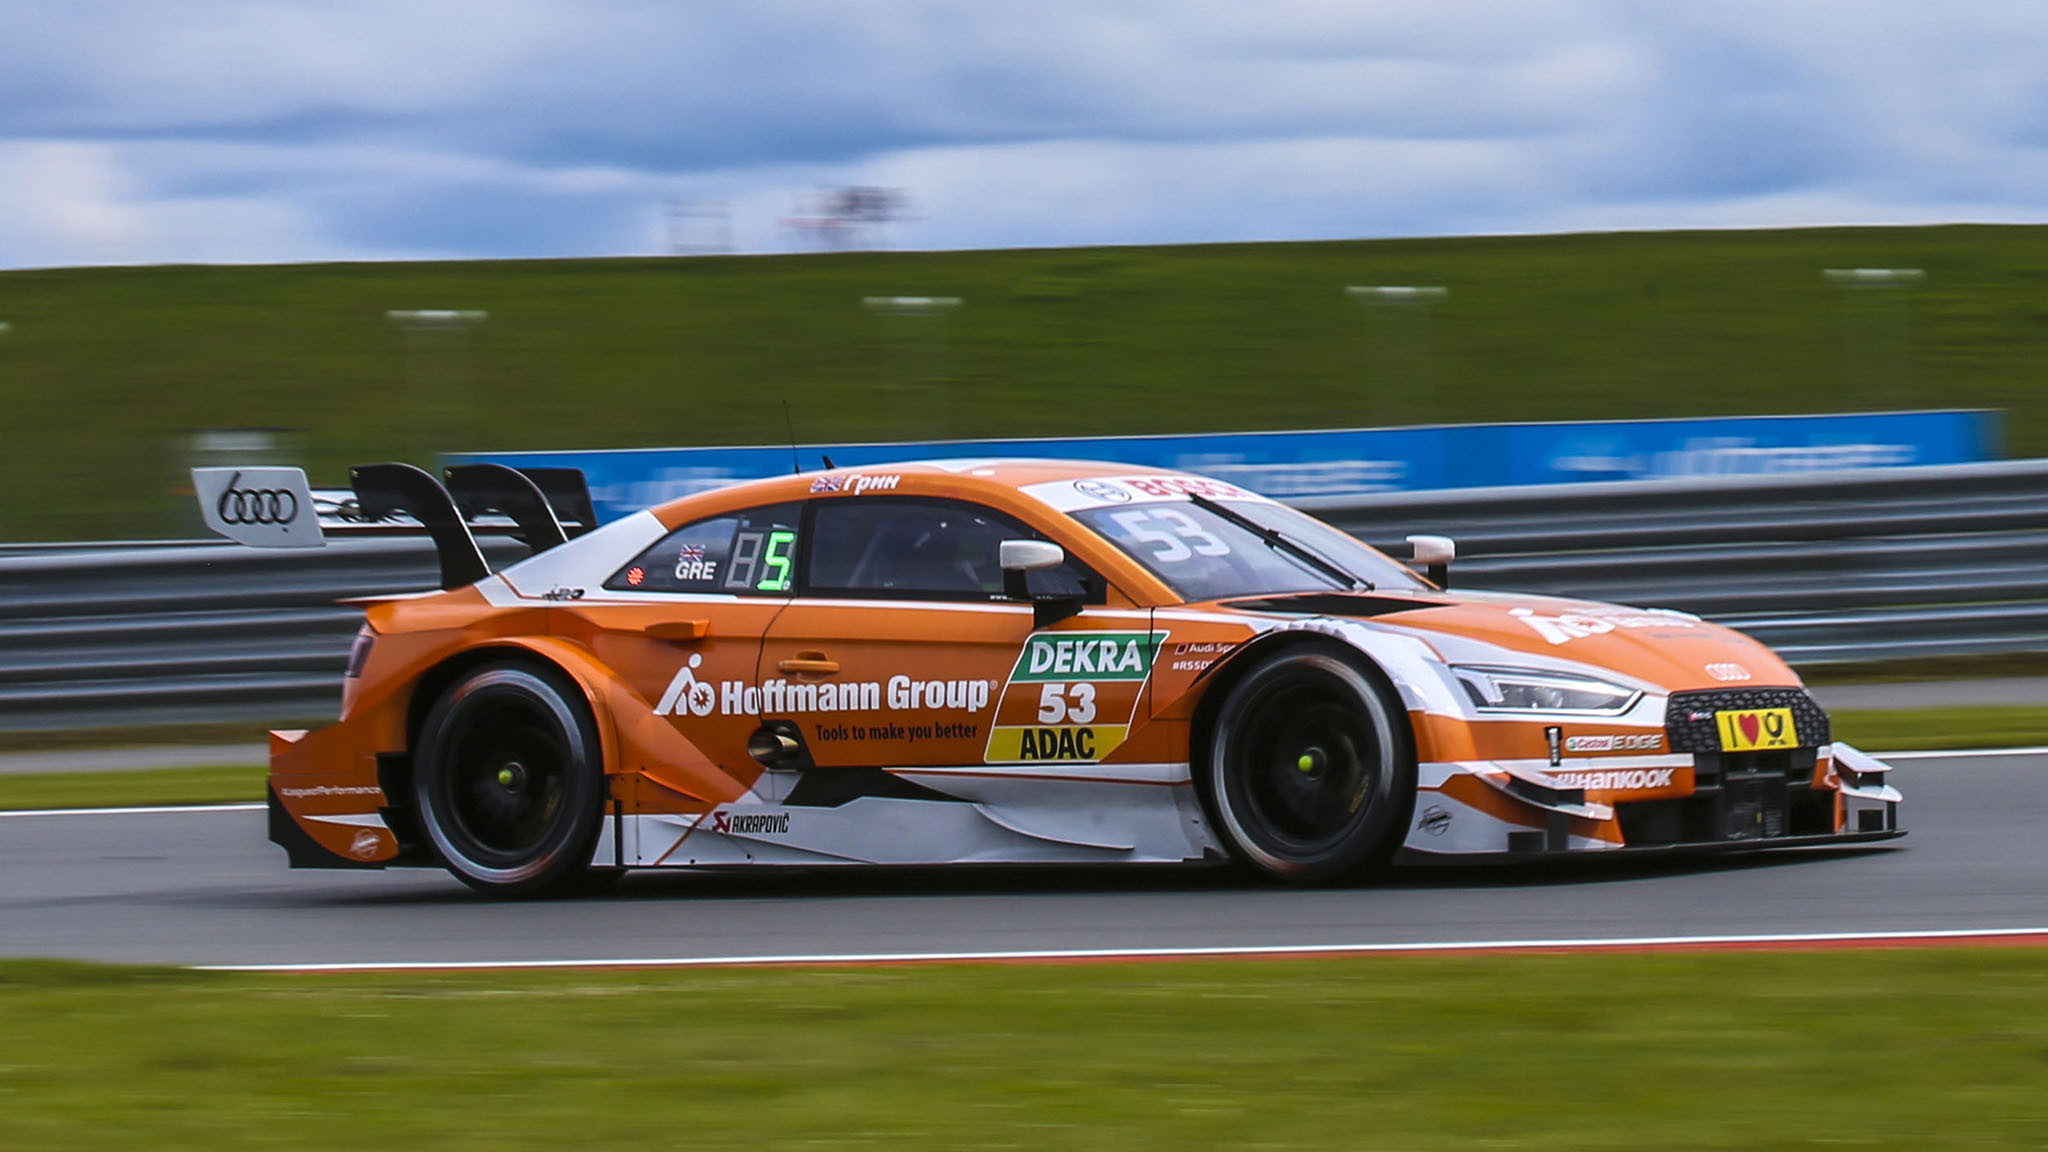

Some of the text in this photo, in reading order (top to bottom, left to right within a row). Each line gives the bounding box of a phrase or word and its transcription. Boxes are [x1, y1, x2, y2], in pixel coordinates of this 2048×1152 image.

[843, 474, 900, 496] Грин
[1109, 508, 1231, 562] 53
[675, 561, 717, 580] GRE
[1029, 639, 1143, 674] DEKRA
[1189, 643, 1236, 654] Audi Sp
[721, 679, 880, 715] Hoffmann
[1038, 682, 1097, 724] 53
[816, 722, 978, 743] Tools to make you better
[1020, 728, 1096, 760] ADAC
[1612, 734, 1664, 750] EDGE
